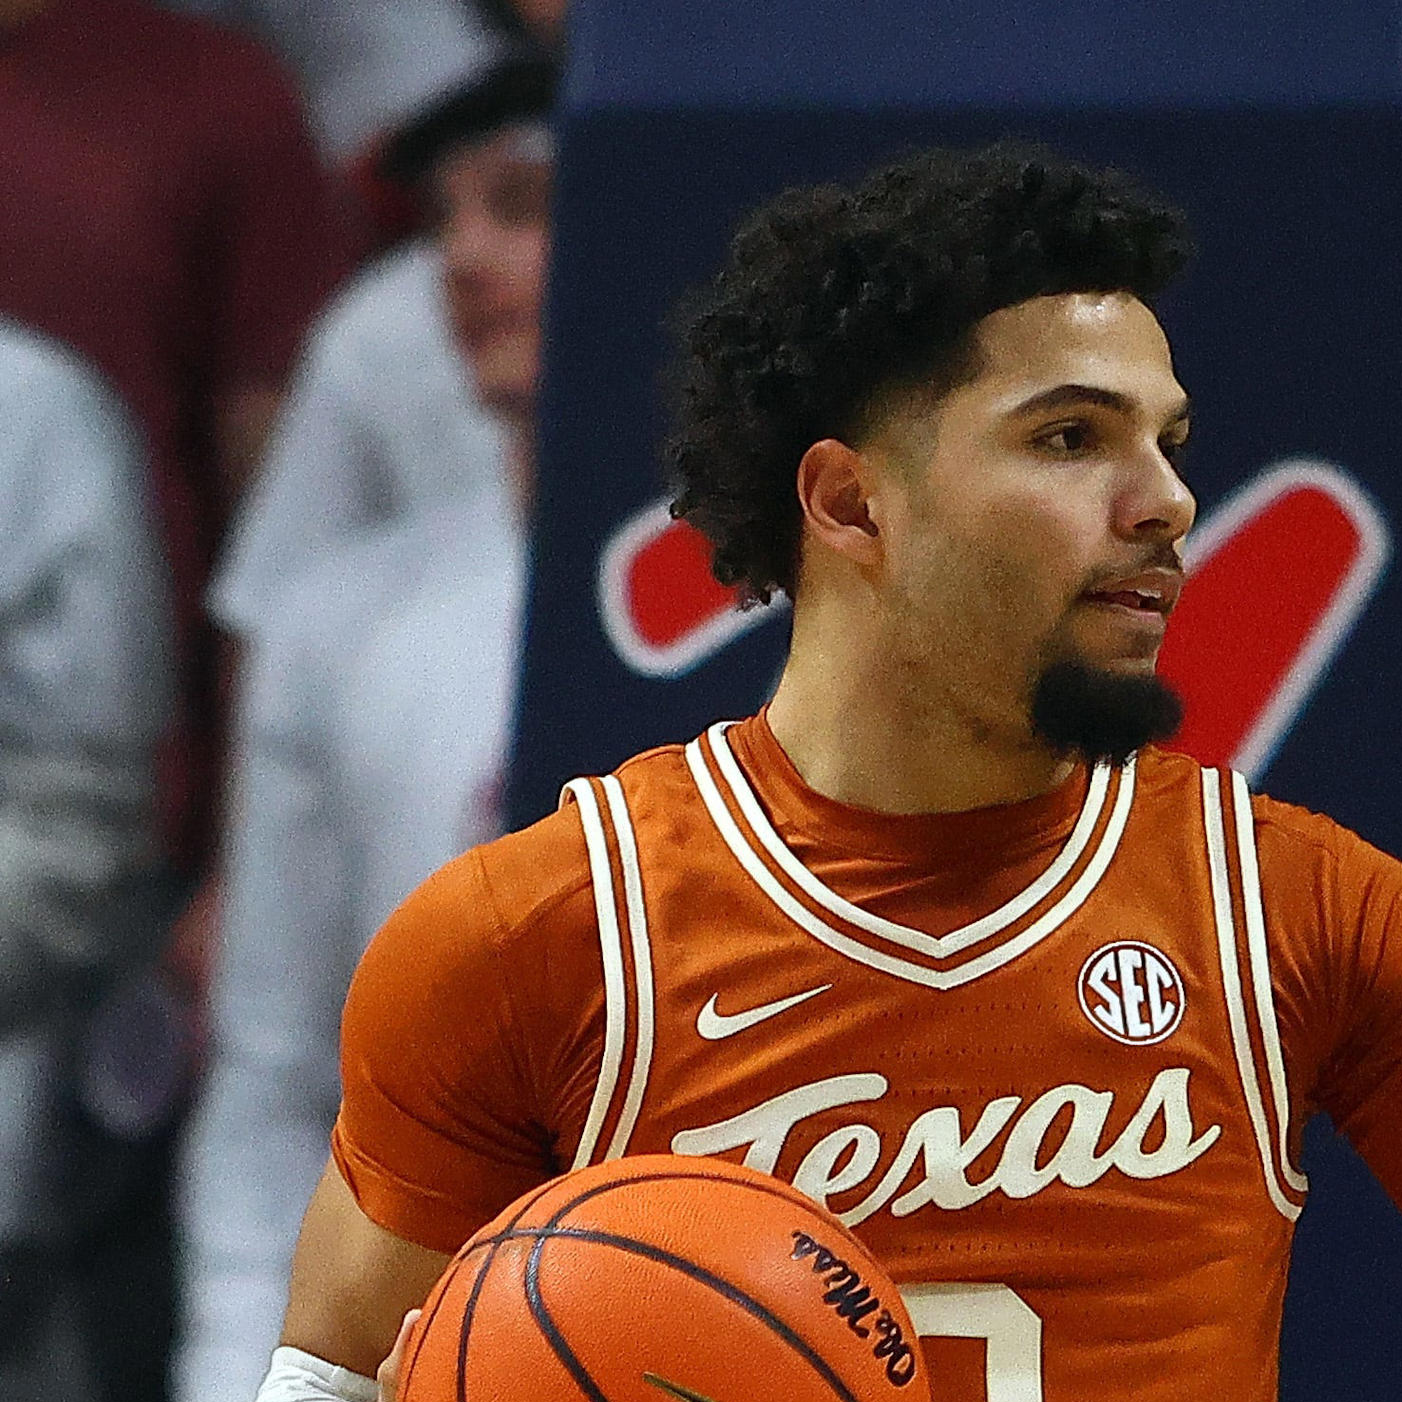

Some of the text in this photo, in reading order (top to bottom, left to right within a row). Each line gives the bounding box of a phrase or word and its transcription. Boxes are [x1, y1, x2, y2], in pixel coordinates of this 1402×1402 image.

[1086, 948, 1176, 1037] SEC
[671, 1068, 1221, 1228] Texas
[790, 1230, 916, 1388] Ole Miss
